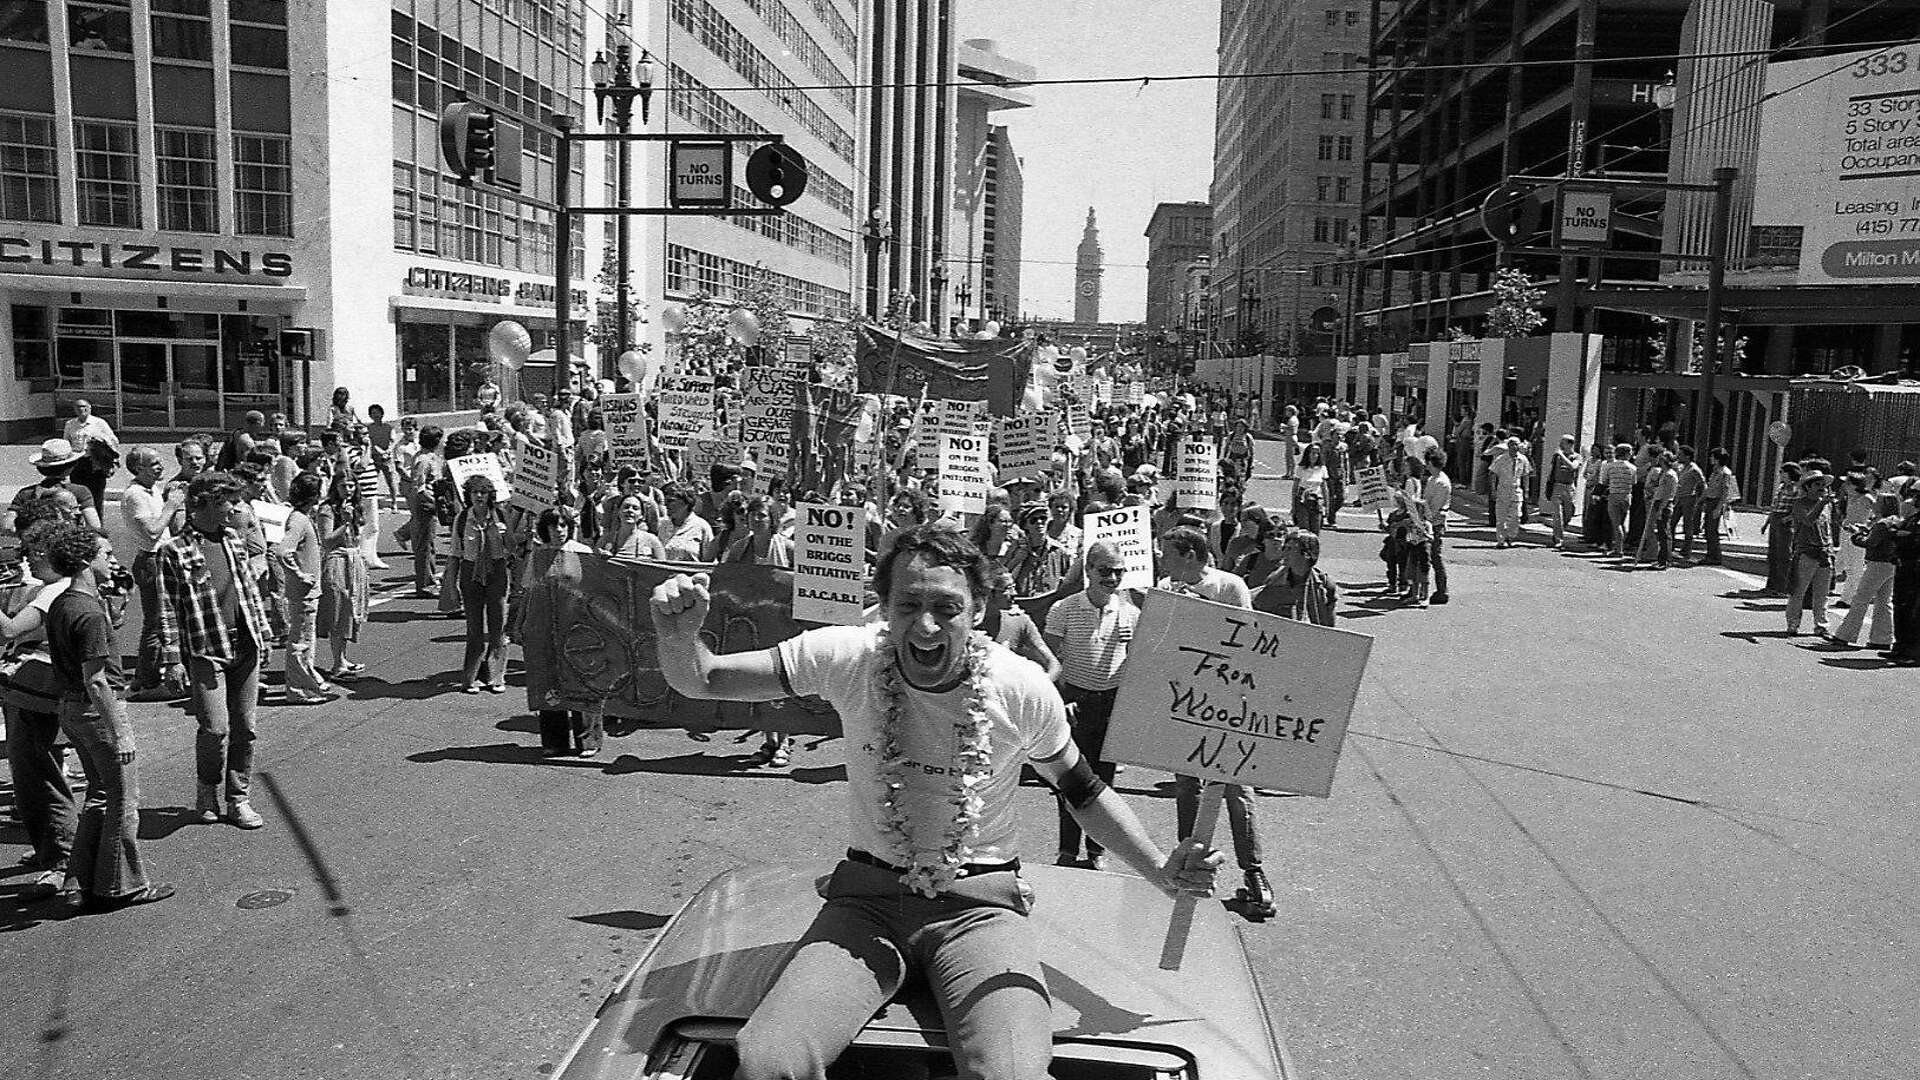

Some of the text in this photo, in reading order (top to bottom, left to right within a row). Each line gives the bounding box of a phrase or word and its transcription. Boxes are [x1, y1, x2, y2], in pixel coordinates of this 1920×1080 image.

[1852, 52, 1907, 78] 333
[1848, 102, 1872, 117] 33
[1845, 118, 1911, 134] 5 Story
[1845, 136, 1881, 152] Total
[689, 163, 710, 174] NO
[1841, 153, 1920, 170] Occupan
[678, 174, 723, 186] TURNS
[1576, 206, 1596, 218] NO
[1835, 200, 1899, 215] Leasing
[1564, 216, 1607, 229] TURNS
[1856, 217, 1920, 234] (415) 77
[0, 237, 292, 277] CITIZENS
[1845, 250, 1898, 266] Milton
[403, 266, 500, 297] CITIZENS
[946, 401, 971, 412] NO!
[1004, 418, 1030, 431] NO!
[949, 437, 981, 452] NO!
[1184, 443, 1211, 456] NO!
[524, 443, 551, 462] NO!
[458, 456, 489, 466] NO!
[806, 507, 854, 530] NO!
[1097, 509, 1139, 528] NO!
[806, 533, 853, 547] ON THE
[1096, 528, 1137, 540] ON THE
[806, 549, 852, 564] BRIGGS
[798, 564, 861, 581] INITIATIVE
[1186, 731, 1257, 777] N.Y.
